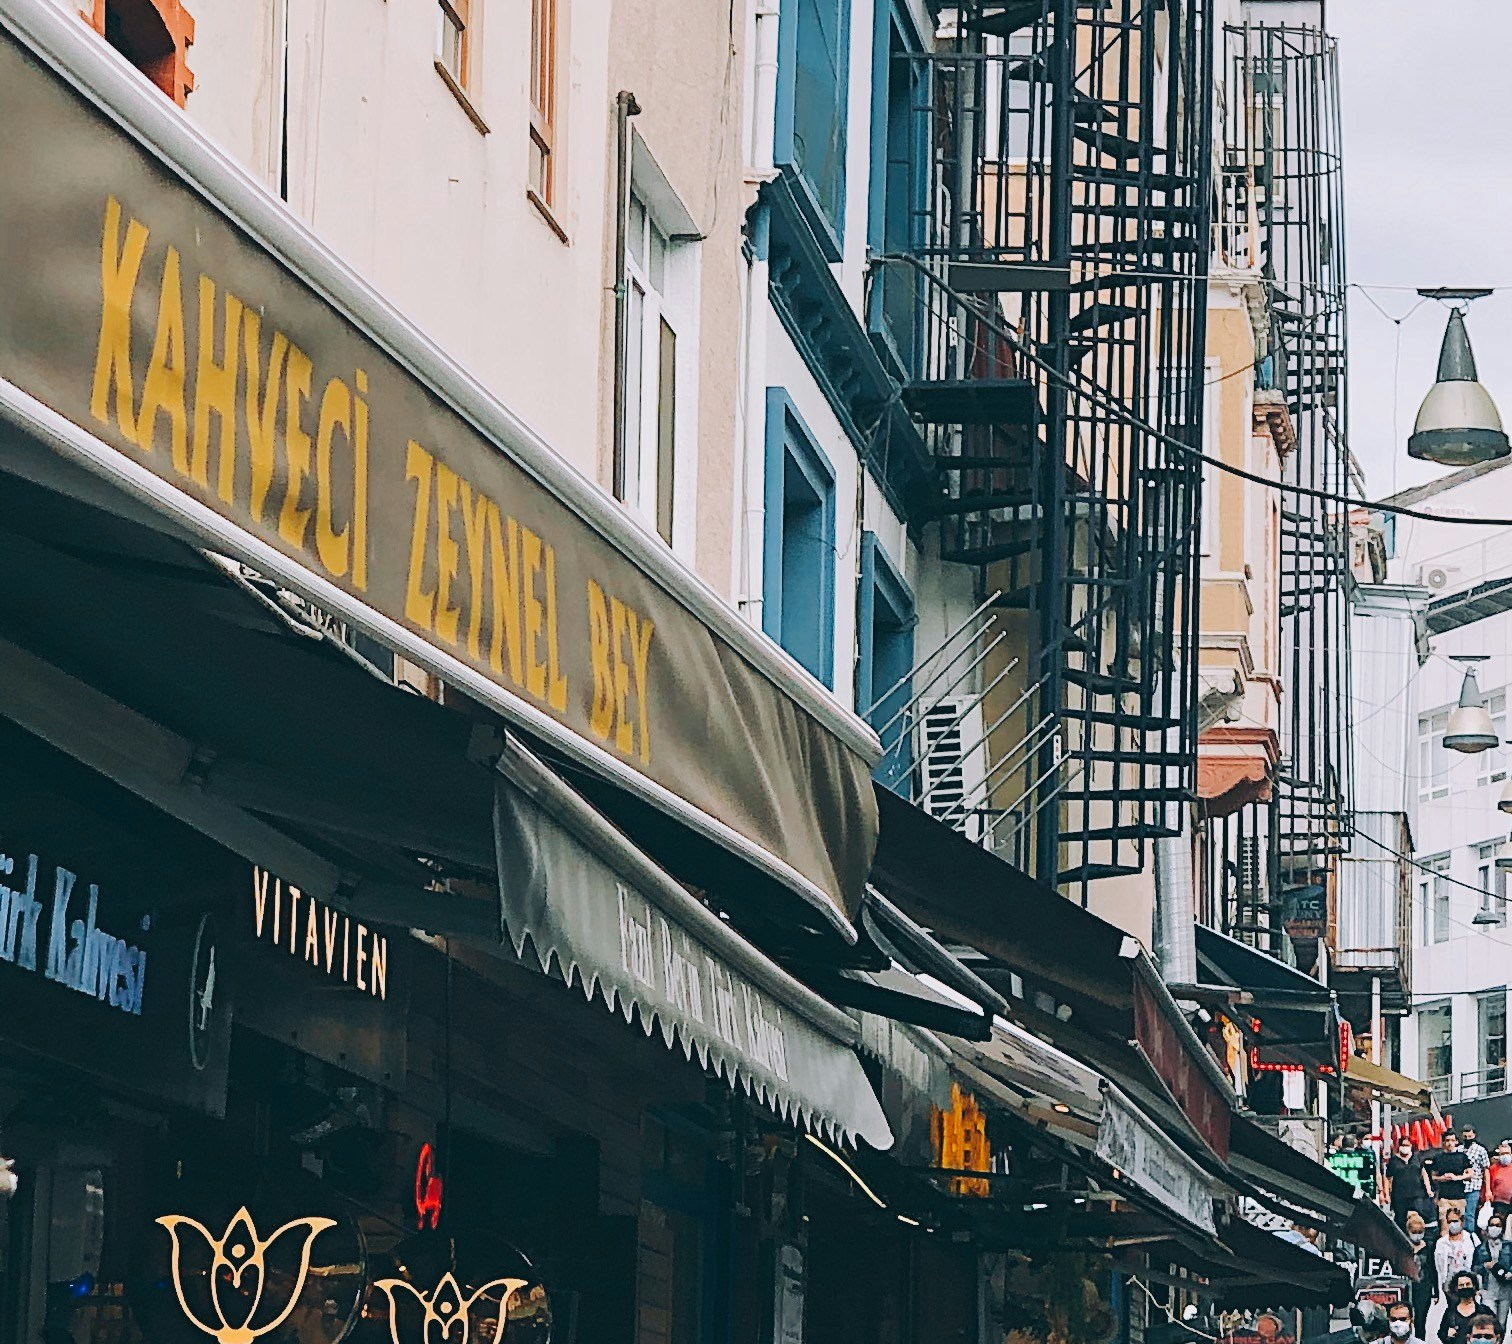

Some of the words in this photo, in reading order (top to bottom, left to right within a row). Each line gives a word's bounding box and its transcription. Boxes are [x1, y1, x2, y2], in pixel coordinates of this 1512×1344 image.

[91, 194, 369, 593] KAHVECİ
[405, 439, 568, 714] ZEYNEL
[588, 578, 655, 767] BEY
[253, 865, 387, 1001] VITAVIEN
